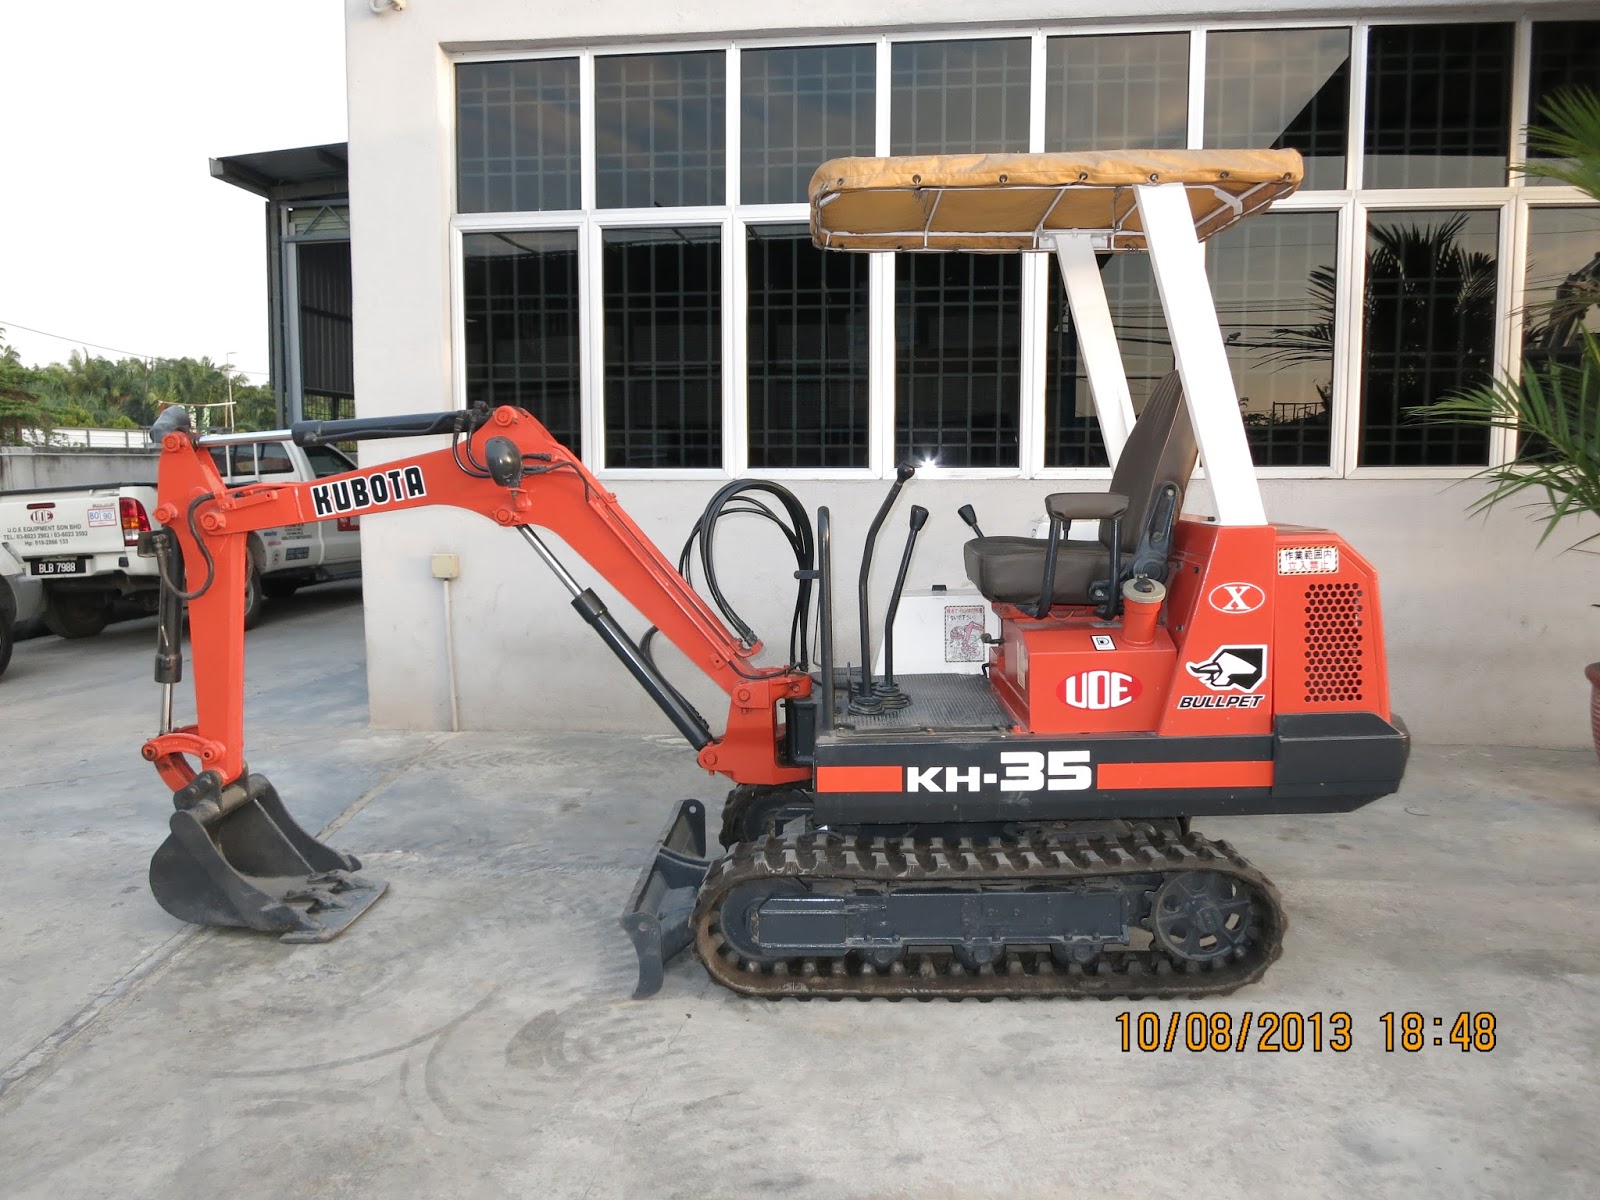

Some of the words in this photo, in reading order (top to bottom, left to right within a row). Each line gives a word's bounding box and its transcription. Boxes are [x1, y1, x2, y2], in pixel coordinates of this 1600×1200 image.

[311, 466, 426, 517] KUBOTA
[89, 512, 99, 520] 80
[1285, 549, 1332, 561] 作業範囲内
[38, 563, 54, 574] BLB
[1288, 560, 1330, 571] 立入禁止
[1226, 586, 1252, 610] X
[1066, 670, 1132, 709] UOE
[1179, 695, 1265, 709] BULLPET
[907, 751, 1092, 792] KH-35
